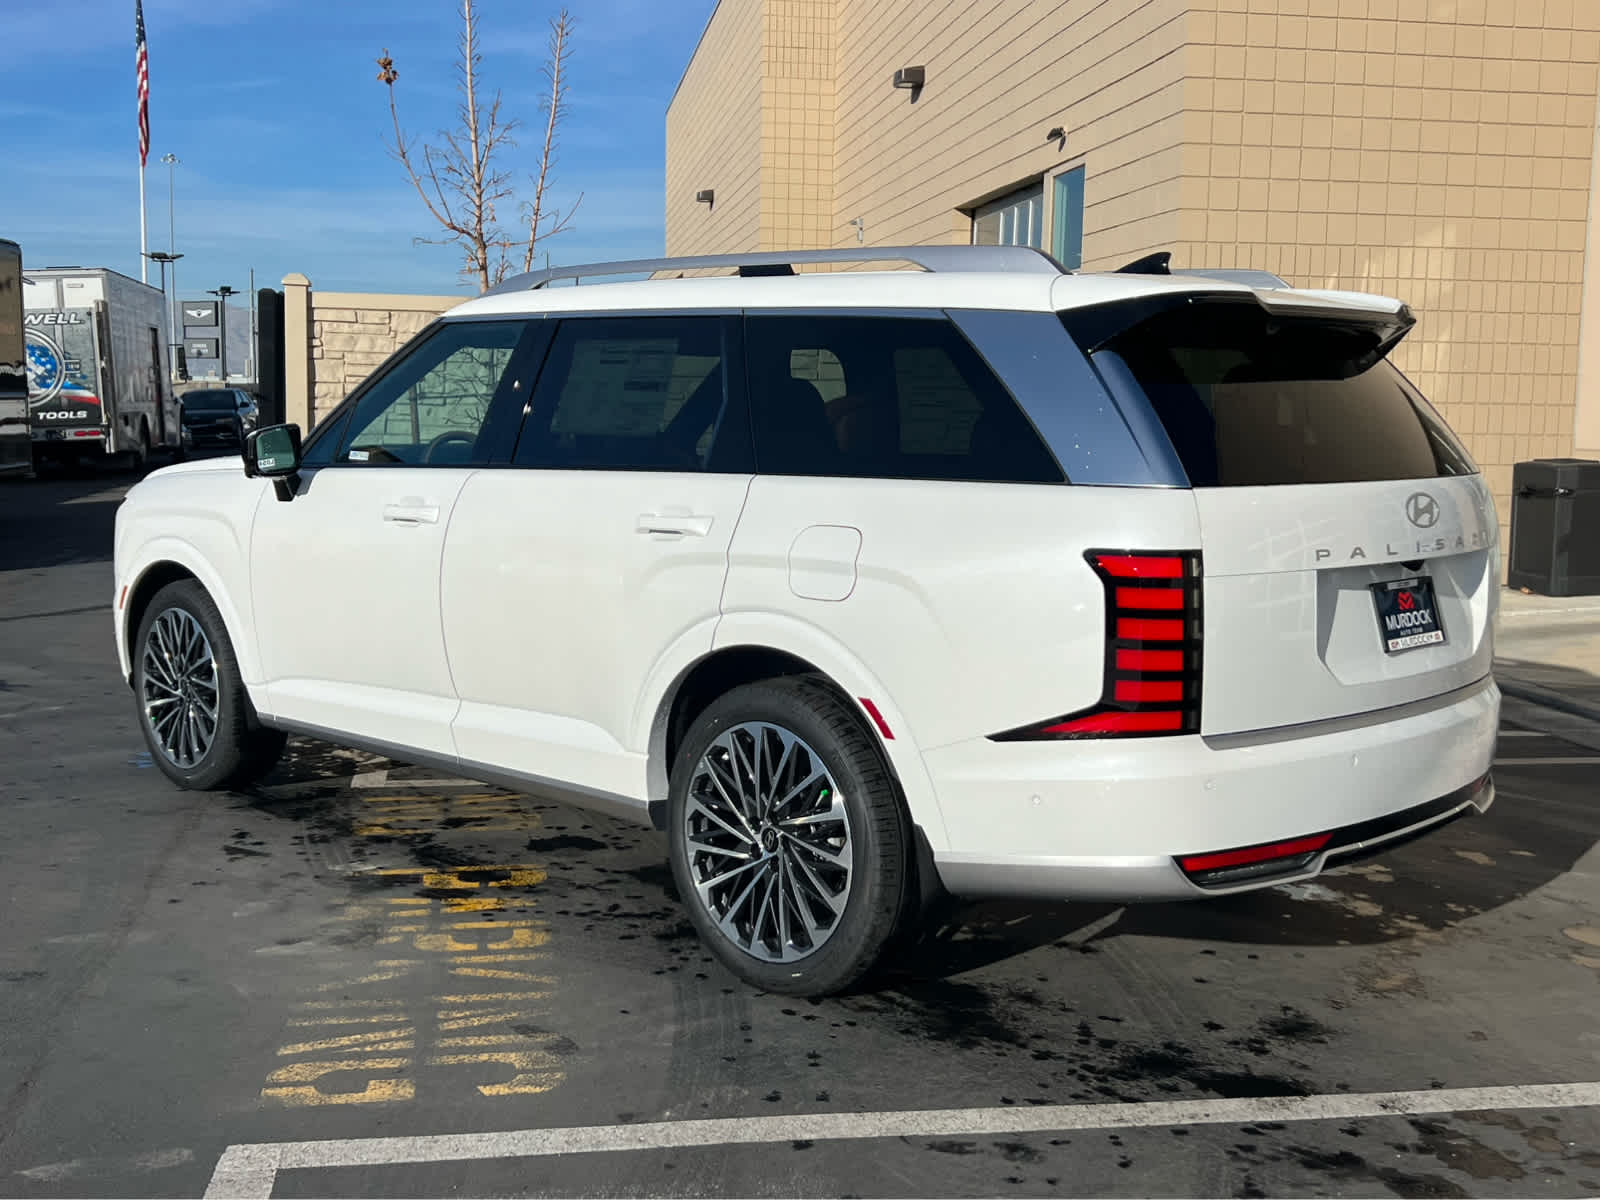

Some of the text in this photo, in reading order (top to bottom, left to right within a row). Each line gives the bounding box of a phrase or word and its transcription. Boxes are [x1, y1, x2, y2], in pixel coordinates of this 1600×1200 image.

[37, 410, 88, 420] TOOLS
[1315, 530, 1488, 561] PALISA
[1385, 609, 1432, 631] MURDOCK
